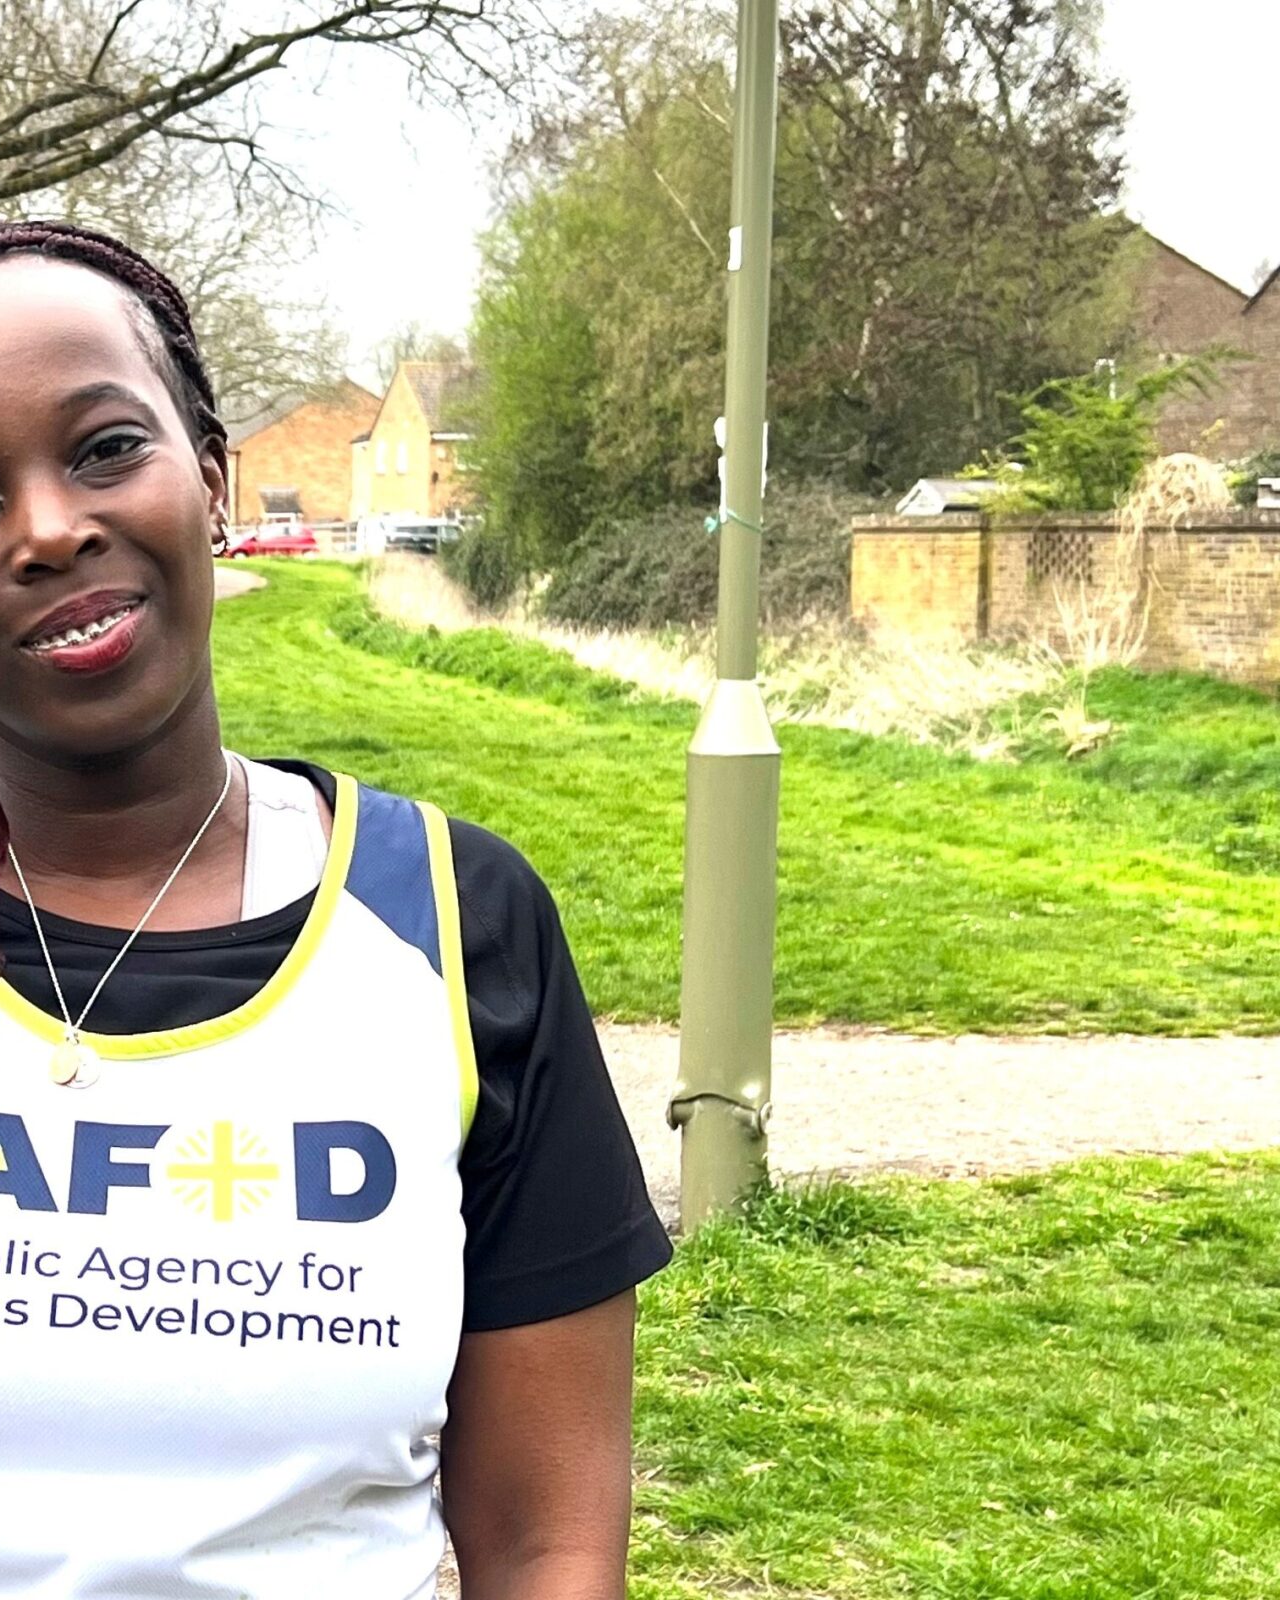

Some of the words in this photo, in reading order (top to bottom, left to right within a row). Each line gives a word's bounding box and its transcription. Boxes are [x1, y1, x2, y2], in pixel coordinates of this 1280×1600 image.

[77, 1246, 283, 1297] Agency
[298, 1252, 363, 1293] for
[49, 1293, 401, 1348] Development
